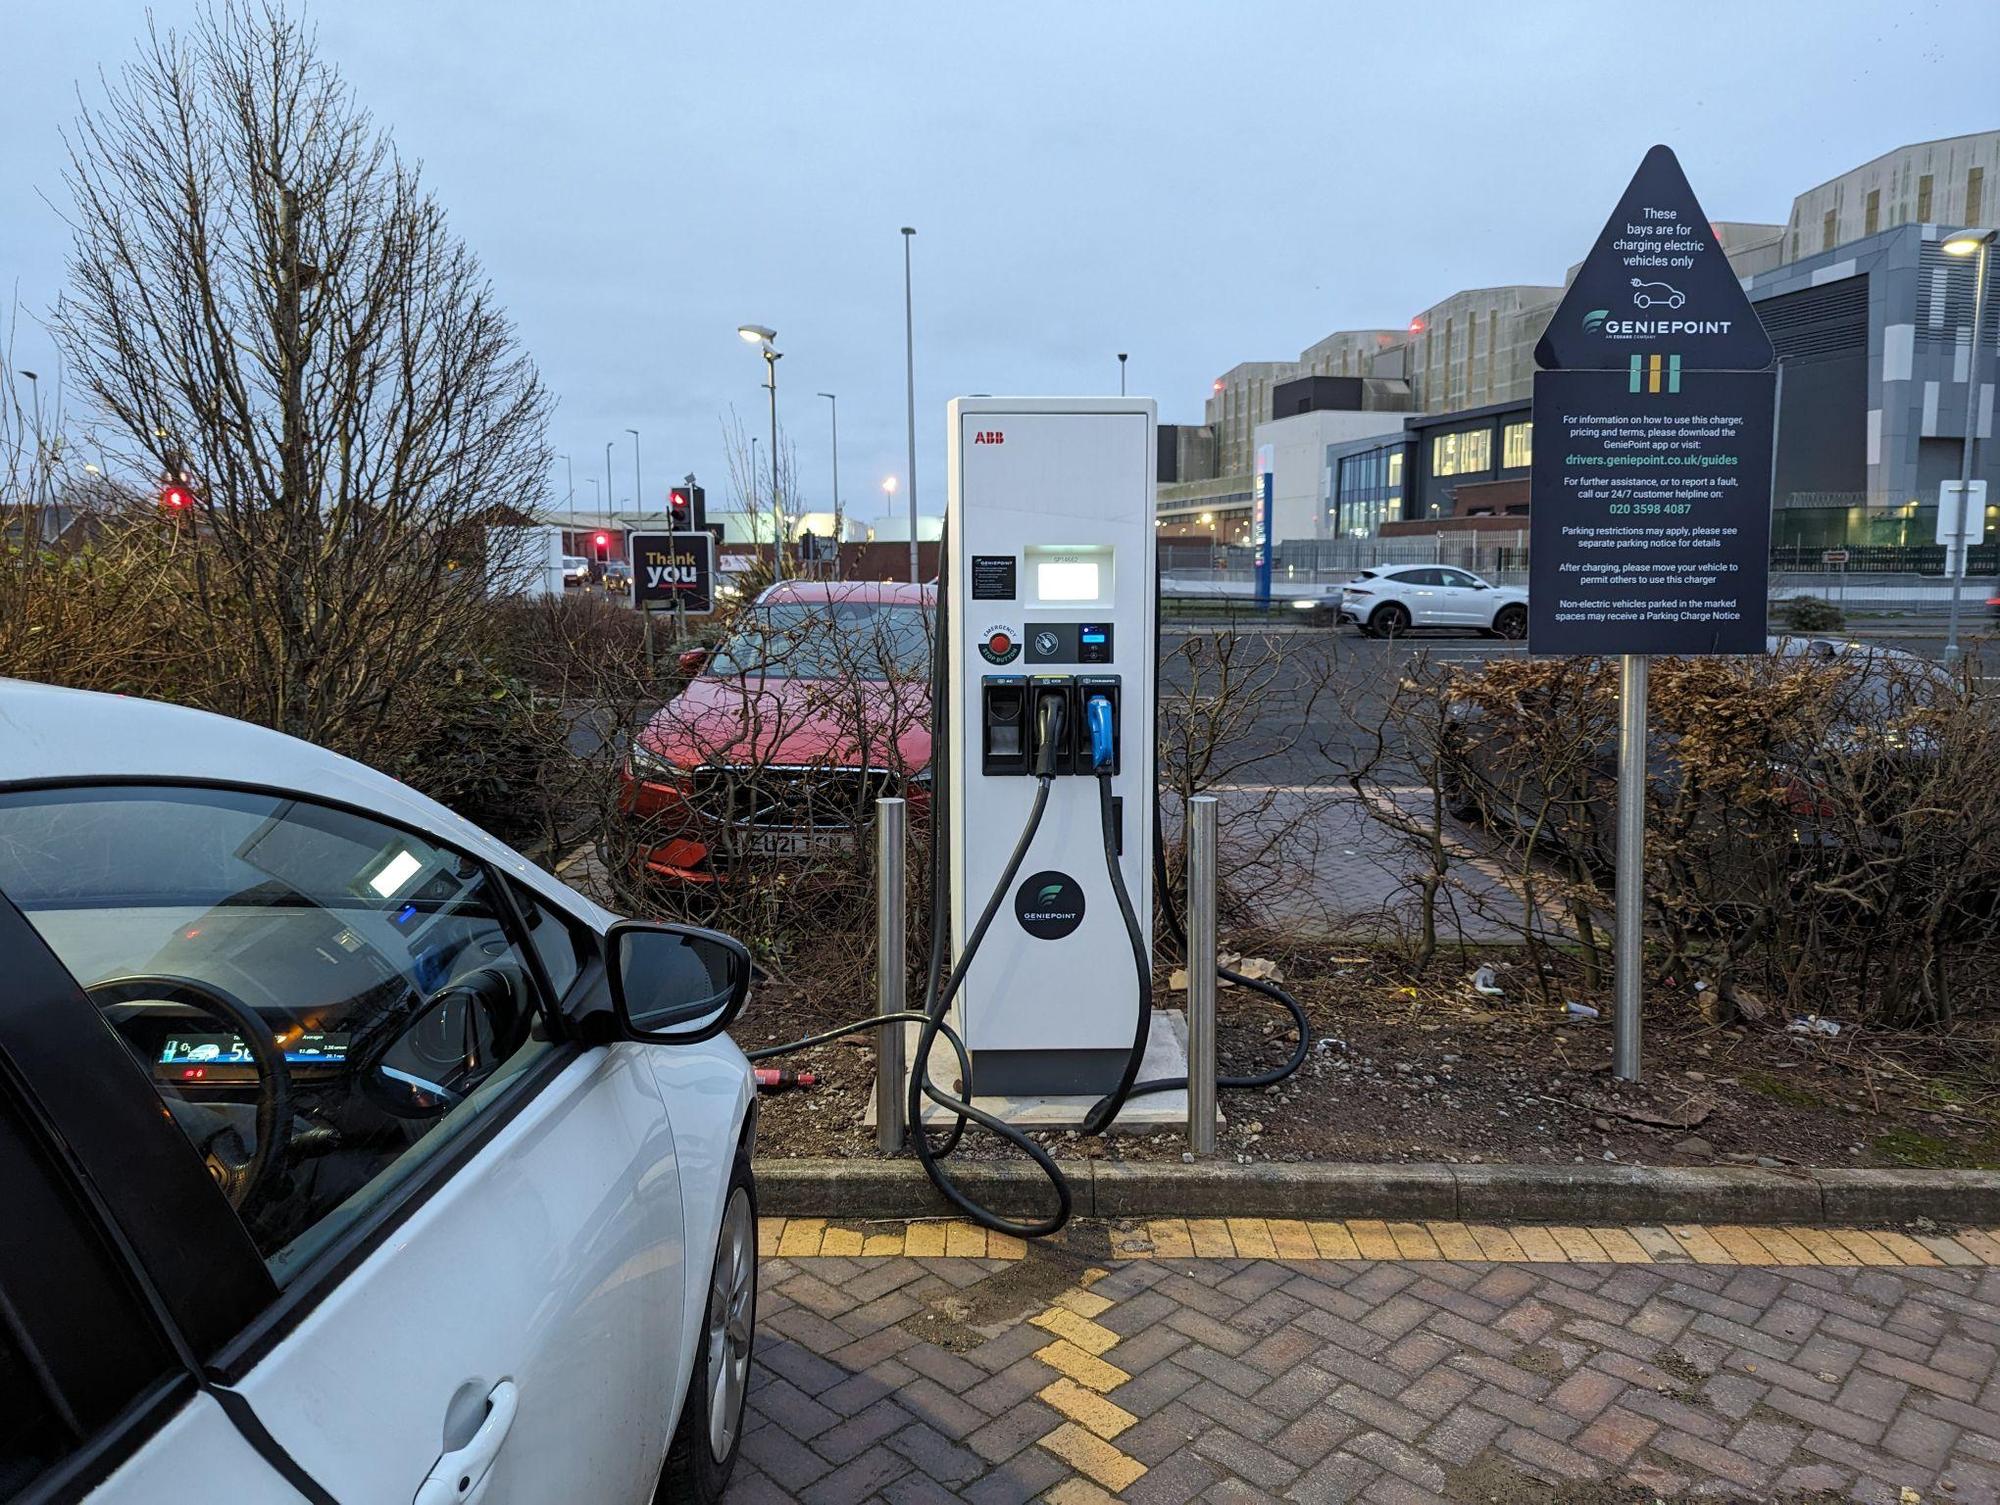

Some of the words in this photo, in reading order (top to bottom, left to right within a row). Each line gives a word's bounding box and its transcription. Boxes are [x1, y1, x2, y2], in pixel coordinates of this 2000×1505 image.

[1643, 208, 1677, 219] These
[1627, 223, 1653, 236] bays
[1656, 226, 1673, 235] are
[1676, 224, 1691, 235] for
[1614, 239, 1661, 253] charging
[1664, 240, 1704, 251] electric
[1624, 255, 1668, 266] vehicles
[1671, 255, 1694, 269] only
[1606, 321, 1731, 333] GENIEPOINT
[1563, 415, 1578, 423] For
[1579, 415, 1628, 424] information
[1643, 416, 1662, 424] how
[1664, 416, 1672, 424] to
[1692, 416, 1708, 424] this
[1710, 416, 1743, 425] charger,
[975, 432, 1004, 444] ABB
[1570, 428, 1599, 438] pricing
[1601, 428, 1617, 436] and
[1619, 429, 1646, 437] terms,
[1648, 428, 1676, 438] please
[1678, 428, 1720, 436] download
[1722, 428, 1735, 436] the
[1604, 440, 1650, 449] GeniePoint
[1652, 442, 1668, 450] app
[1566, 454, 1737, 467] drivers.geniepoint.co.uk/guides
[1564, 477, 1578, 485] For
[1580, 477, 1609, 485] further
[1611, 477, 1658, 486] assistance,
[1682, 478, 1707, 487] report
[1717, 477, 1738, 486] fault,
[1578, 490, 1593, 498] call
[1611, 490, 1631, 498] 24/7
[1675, 490, 1708, 499] helpline
[1610, 504, 1630, 514] 020
[1633, 504, 1661, 514] 3598
[1663, 504, 1691, 514] 4087
[1562, 527, 1594, 536] Parking
[1596, 527, 1644, 535] restrictions
[1646, 528, 1664, 536] may
[1666, 527, 1690, 536] apply,
[1692, 527, 1720, 536] please
[1578, 540, 1615, 548] separate
[1617, 539, 1648, 549] parking
[1678, 539, 1691, 547] for
[1692, 539, 1721, 547] details
[646, 552, 695, 565] Thank
[1559, 563, 1580, 571] After
[1582, 563, 1621, 573] charging,
[1623, 563, 1650, 573] please
[1677, 565, 1696, 573] your
[1698, 563, 1727, 571] vehicle
[647, 566, 696, 588] you
[1581, 576, 1608, 585] permit
[1610, 575, 1637, 583] others
[1667, 575, 1682, 583] this
[1684, 575, 1716, 585] charger
[1560, 600, 1610, 608] Non-electric
[1612, 600, 1646, 608] vehicles
[1648, 599, 1677, 609] parked
[1704, 599, 1736, 607] marked
[1555, 613, 1585, 622] spaces
[1587, 613, 1606, 622] may
[1607, 612, 1638, 620] receive
[1647, 612, 1679, 621] Parking
[1680, 612, 1711, 621] Charge
[984, 624, 1017, 638] EMERGENCY
[982, 648, 996, 661] STOP
[997, 647, 1018, 663] BUTTON
